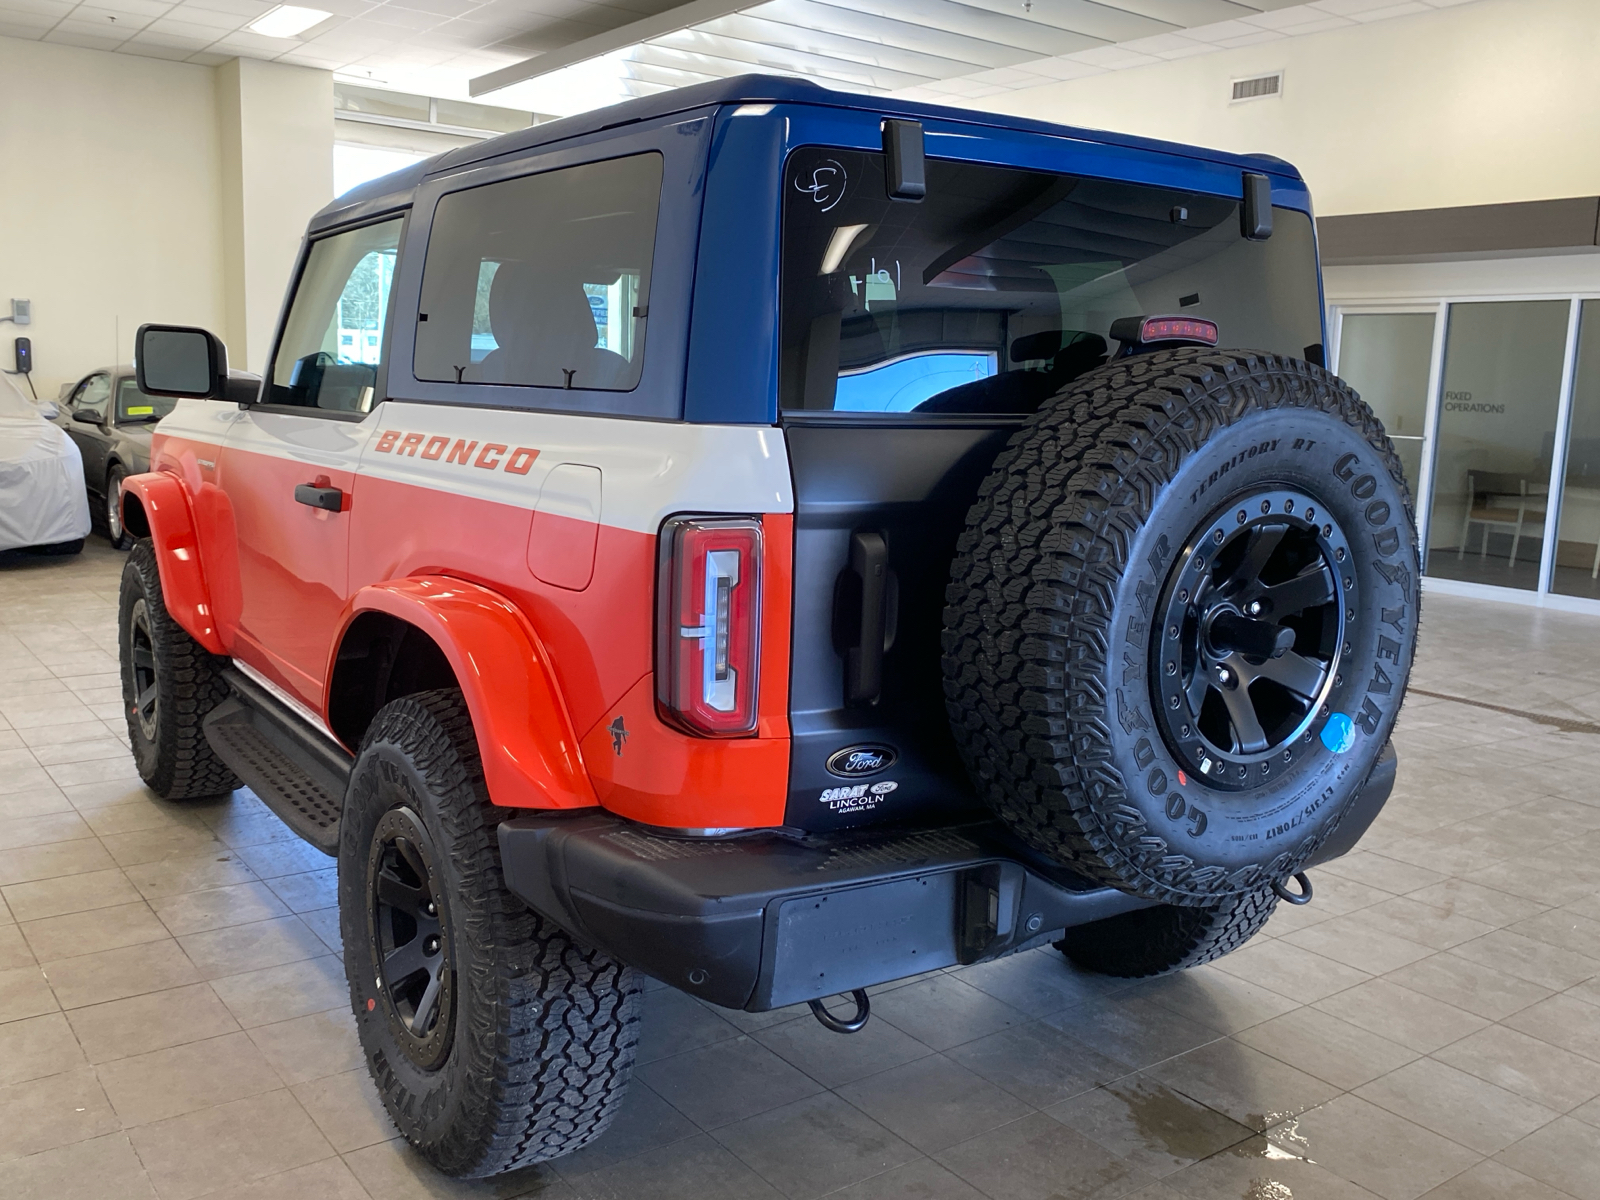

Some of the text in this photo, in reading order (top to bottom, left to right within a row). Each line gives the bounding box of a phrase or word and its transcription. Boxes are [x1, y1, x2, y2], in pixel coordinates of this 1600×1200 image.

[1445, 391, 1472, 401] FIXED
[1445, 401, 1505, 414] OPERATIONS
[375, 430, 541, 475] BRONCO
[1189, 438, 1317, 505] TERRITORY RT
[845, 752, 883, 771] Ford
[819, 784, 870, 802] SARAT
[829, 794, 884, 809] LINCOLN
[1266, 786, 1334, 839] LT315/70R17
